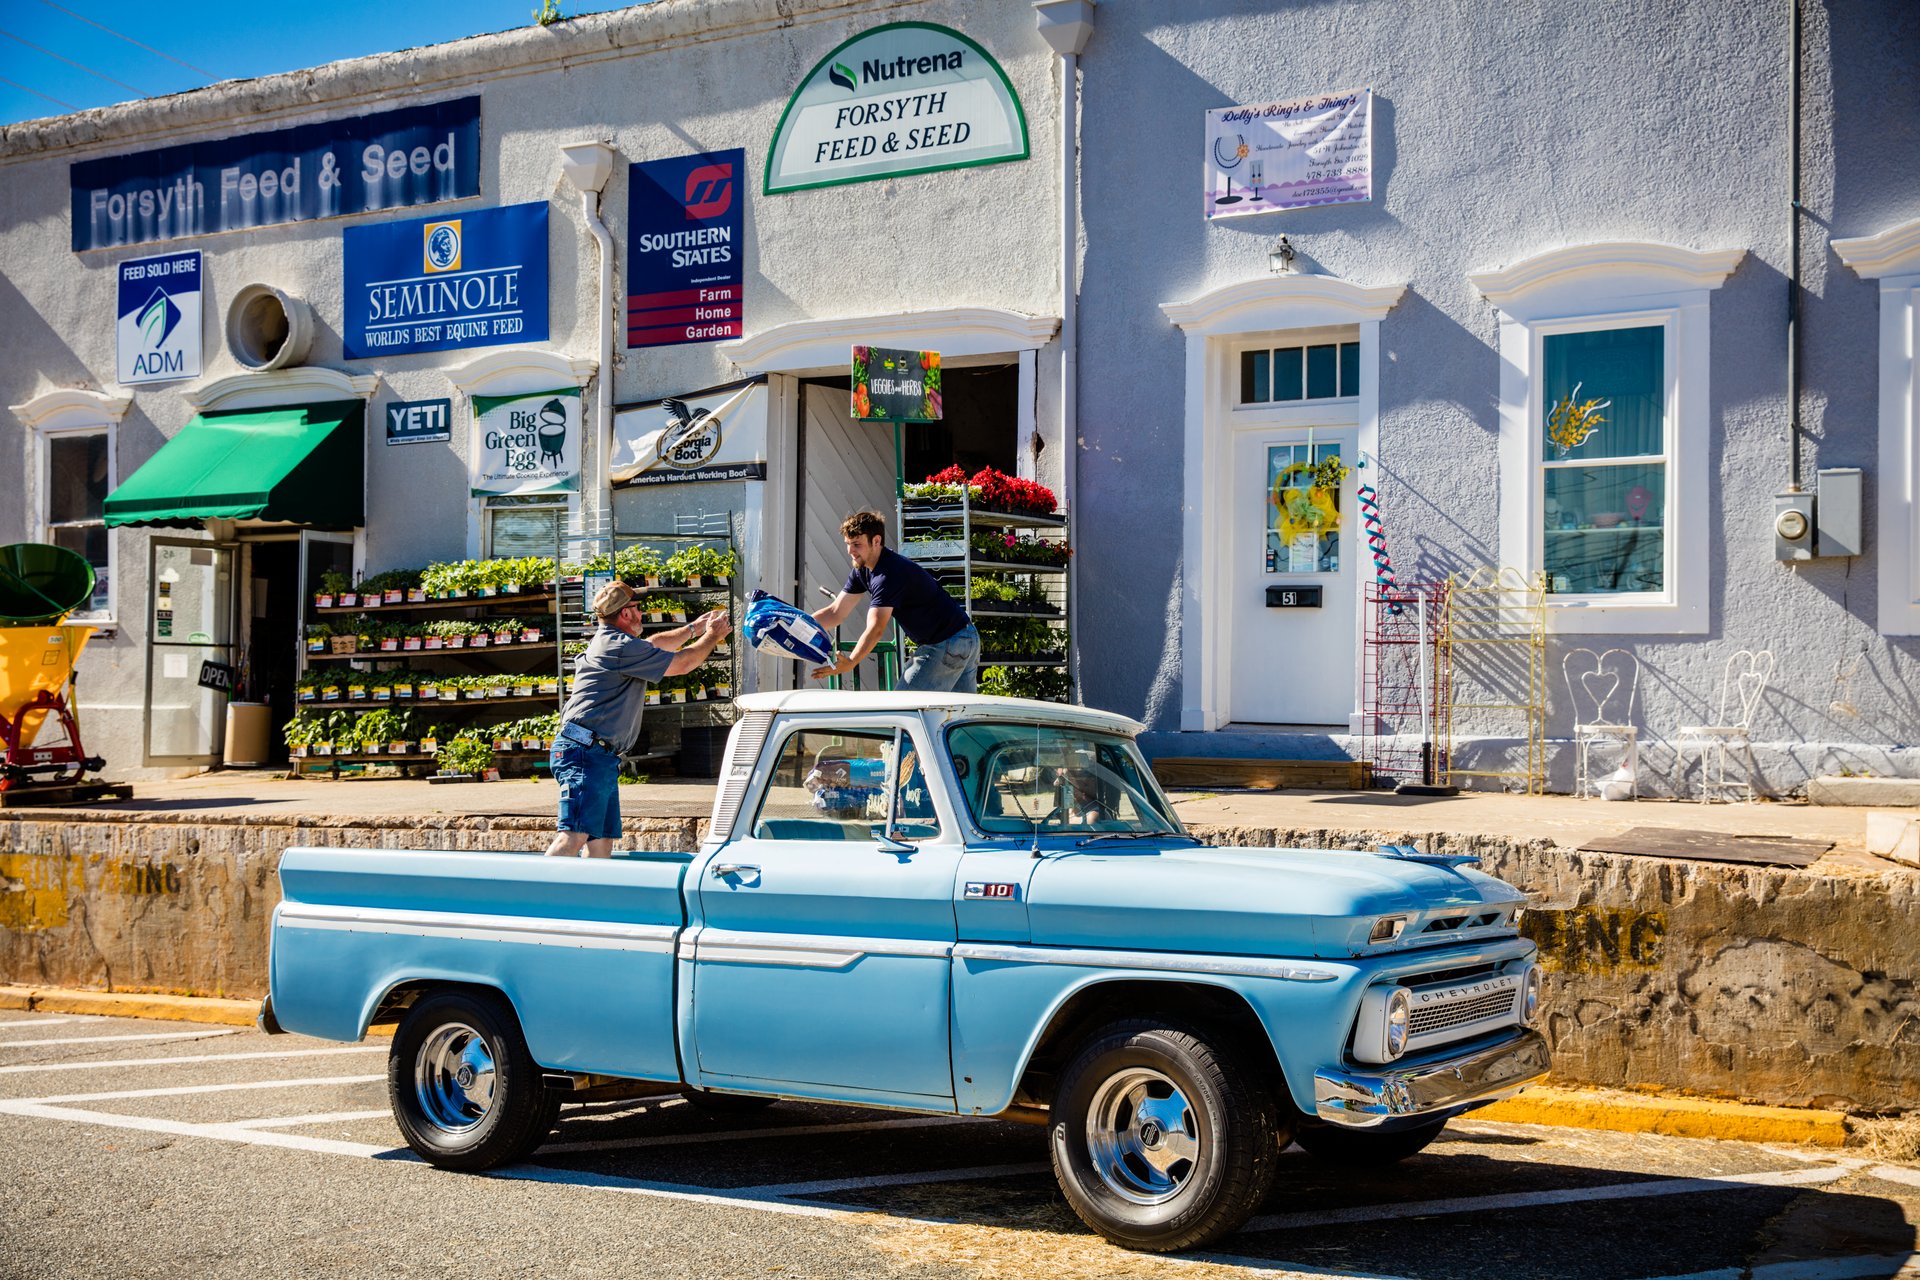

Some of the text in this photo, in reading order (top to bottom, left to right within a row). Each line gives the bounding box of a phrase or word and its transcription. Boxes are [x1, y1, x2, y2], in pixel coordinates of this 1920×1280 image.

[862, 50, 962, 84] Nutrena
[835, 91, 948, 129] FORSYTH
[1221, 94, 1356, 125] Dolly's Ring's & Thing's
[814, 122, 971, 163] FEED & SEED
[90, 132, 455, 224] Forsyth Feed & Seed
[640, 225, 731, 253] SOUTHERN
[672, 245, 732, 268] STATES
[123, 258, 196, 281] FEED SOLD HERE
[369, 271, 519, 323] SEMINOLE
[699, 288, 732, 302] Farm
[695, 306, 732, 320] Home
[365, 317, 523, 348] WORLD'S BEST EQUINE FEED
[685, 324, 732, 339] Garden
[132, 349, 183, 376] ADM
[870, 378, 895, 395] VEGGIES
[902, 379, 922, 396] HERBS
[389, 404, 445, 432] YETI
[510, 411, 536, 432] Big
[485, 431, 536, 450] Green
[667, 435, 711, 452] eorgia
[505, 449, 536, 471] Egg
[674, 449, 703, 460] Boot
[629, 475, 666, 485] America's
[697, 469, 728, 481] Working
[728, 468, 747, 477] Boot
[1284, 593, 1296, 604] 51
[990, 884, 1007, 896] 10
[1421, 978, 1513, 1003] CHEVROLET
